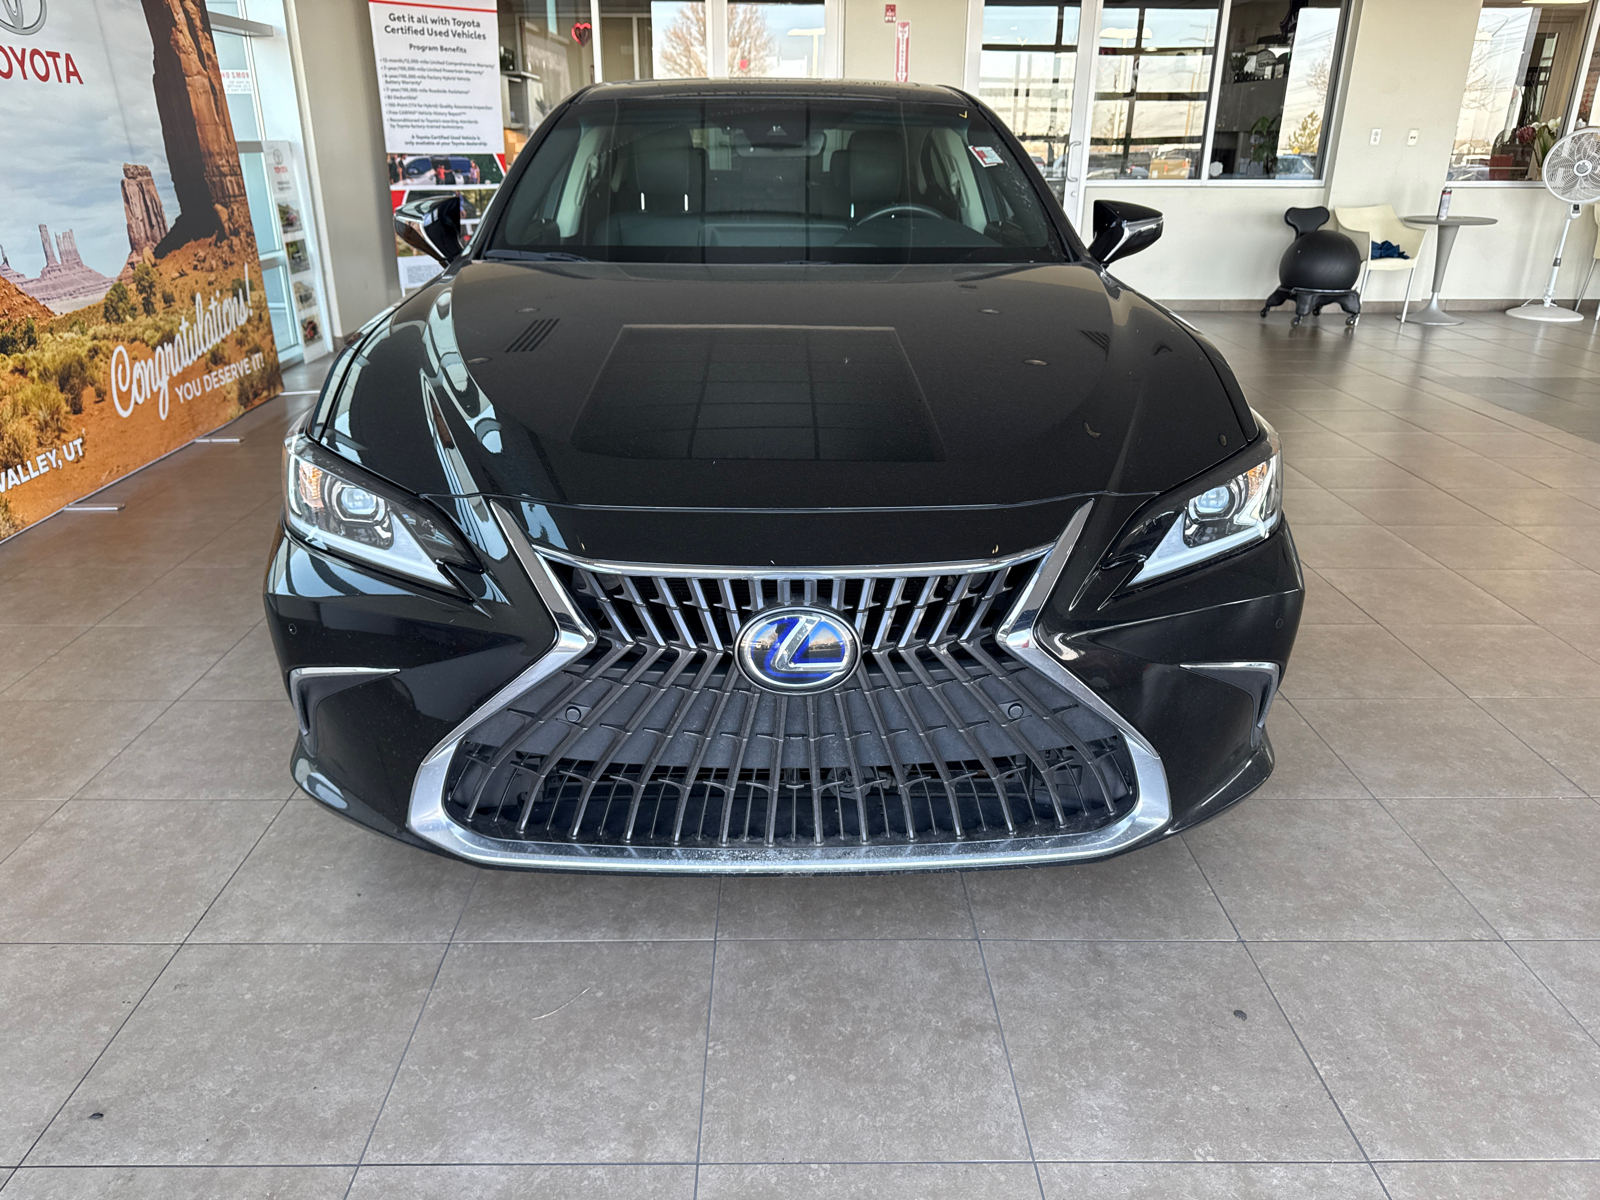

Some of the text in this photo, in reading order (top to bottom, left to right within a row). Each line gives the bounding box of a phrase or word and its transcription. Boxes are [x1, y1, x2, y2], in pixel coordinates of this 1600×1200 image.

[388, 13, 480, 29] Get it all with Toyota
[384, 25, 486, 40] Certified Used Vehicles
[409, 44, 467, 54] Program Benefits
[111, 263, 253, 420] Congratulations!
[175, 352, 265, 404] YOU DESERVE IT!
[62, 438, 84, 461] UT
